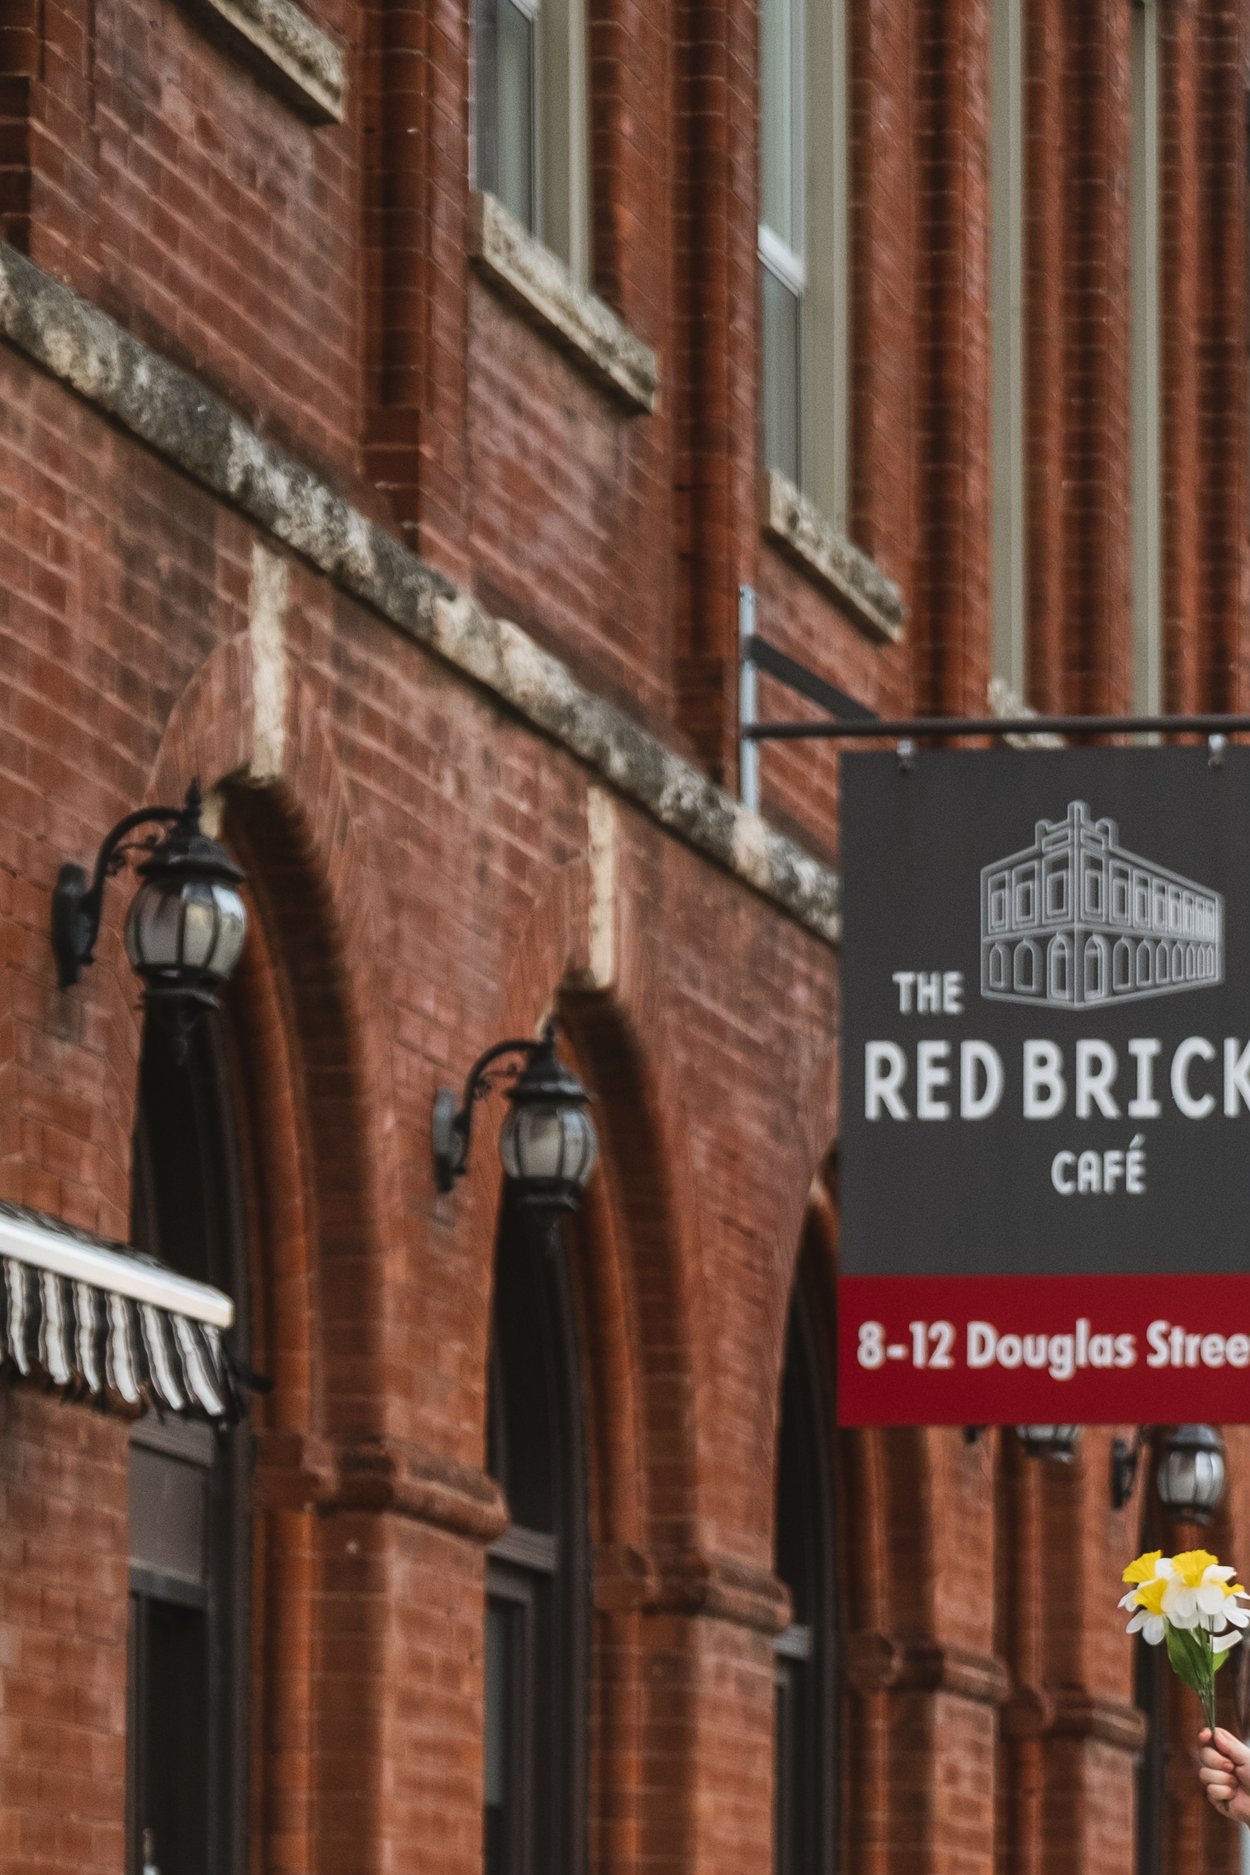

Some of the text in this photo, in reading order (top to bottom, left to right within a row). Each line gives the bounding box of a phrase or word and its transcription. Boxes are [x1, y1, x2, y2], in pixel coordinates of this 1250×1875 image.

[892, 971, 963, 1014] THE
[864, 1039, 1004, 1120] RED
[1050, 1133, 1146, 1195] CAFÉ
[856, 1320, 956, 1370] 8-12
[966, 1318, 1136, 1380] Douglas
